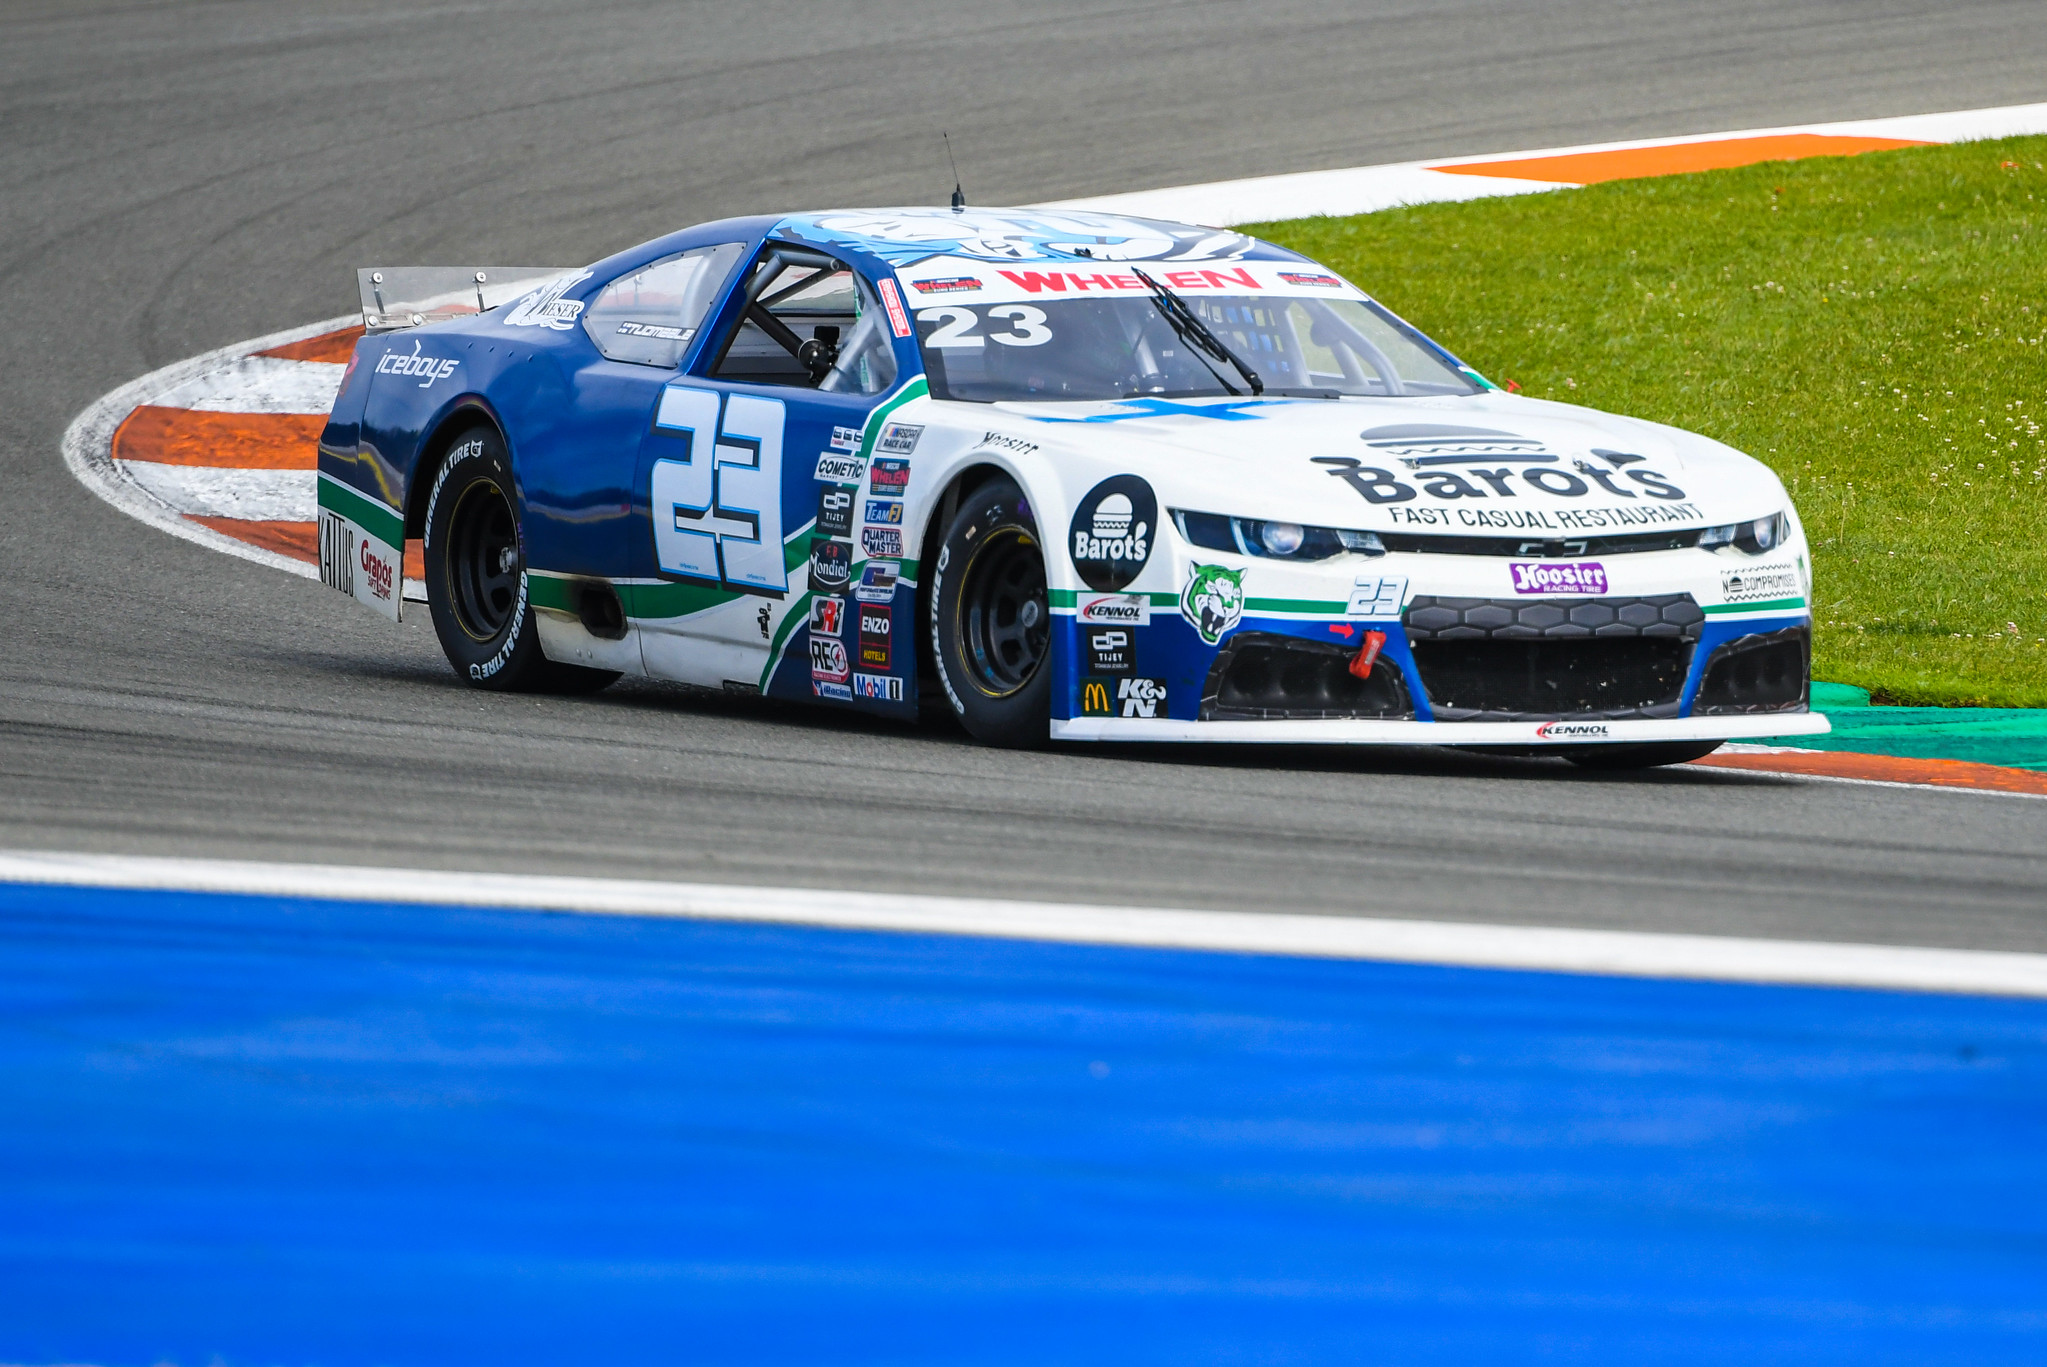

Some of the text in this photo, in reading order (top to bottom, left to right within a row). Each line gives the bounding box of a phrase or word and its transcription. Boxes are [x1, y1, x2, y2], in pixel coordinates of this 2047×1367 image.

[916, 304, 1053, 348] 23
[375, 339, 459, 388] iceboys
[884, 439, 912, 449] RACE CAR
[818, 460, 864, 478] COMETIC
[871, 466, 911, 486] WHELEN
[424, 442, 471, 549] GENERAL TIRE
[651, 385, 788, 593] 23
[825, 511, 845, 522] TIJEY
[1388, 503, 1705, 529] FAST CASUAL RESTAURANT
[863, 529, 900, 545] QUARTER
[869, 542, 902, 554] MASTER
[810, 551, 848, 577] Mondial
[1515, 563, 1604, 590] Hoosier
[1744, 574, 1797, 591] COMPROMISES
[1348, 575, 1408, 615] 23
[502, 571, 528, 658] GENERAL
[1087, 605, 1141, 621] KENNOL
[861, 616, 890, 634] ENZO
[482, 652, 506, 678] TIRE
[863, 650, 886, 662] HOTELS
[1099, 653, 1123, 662] TIJEY
[857, 675, 886, 699] Mobil
[1541, 725, 1608, 738] KENNOL
